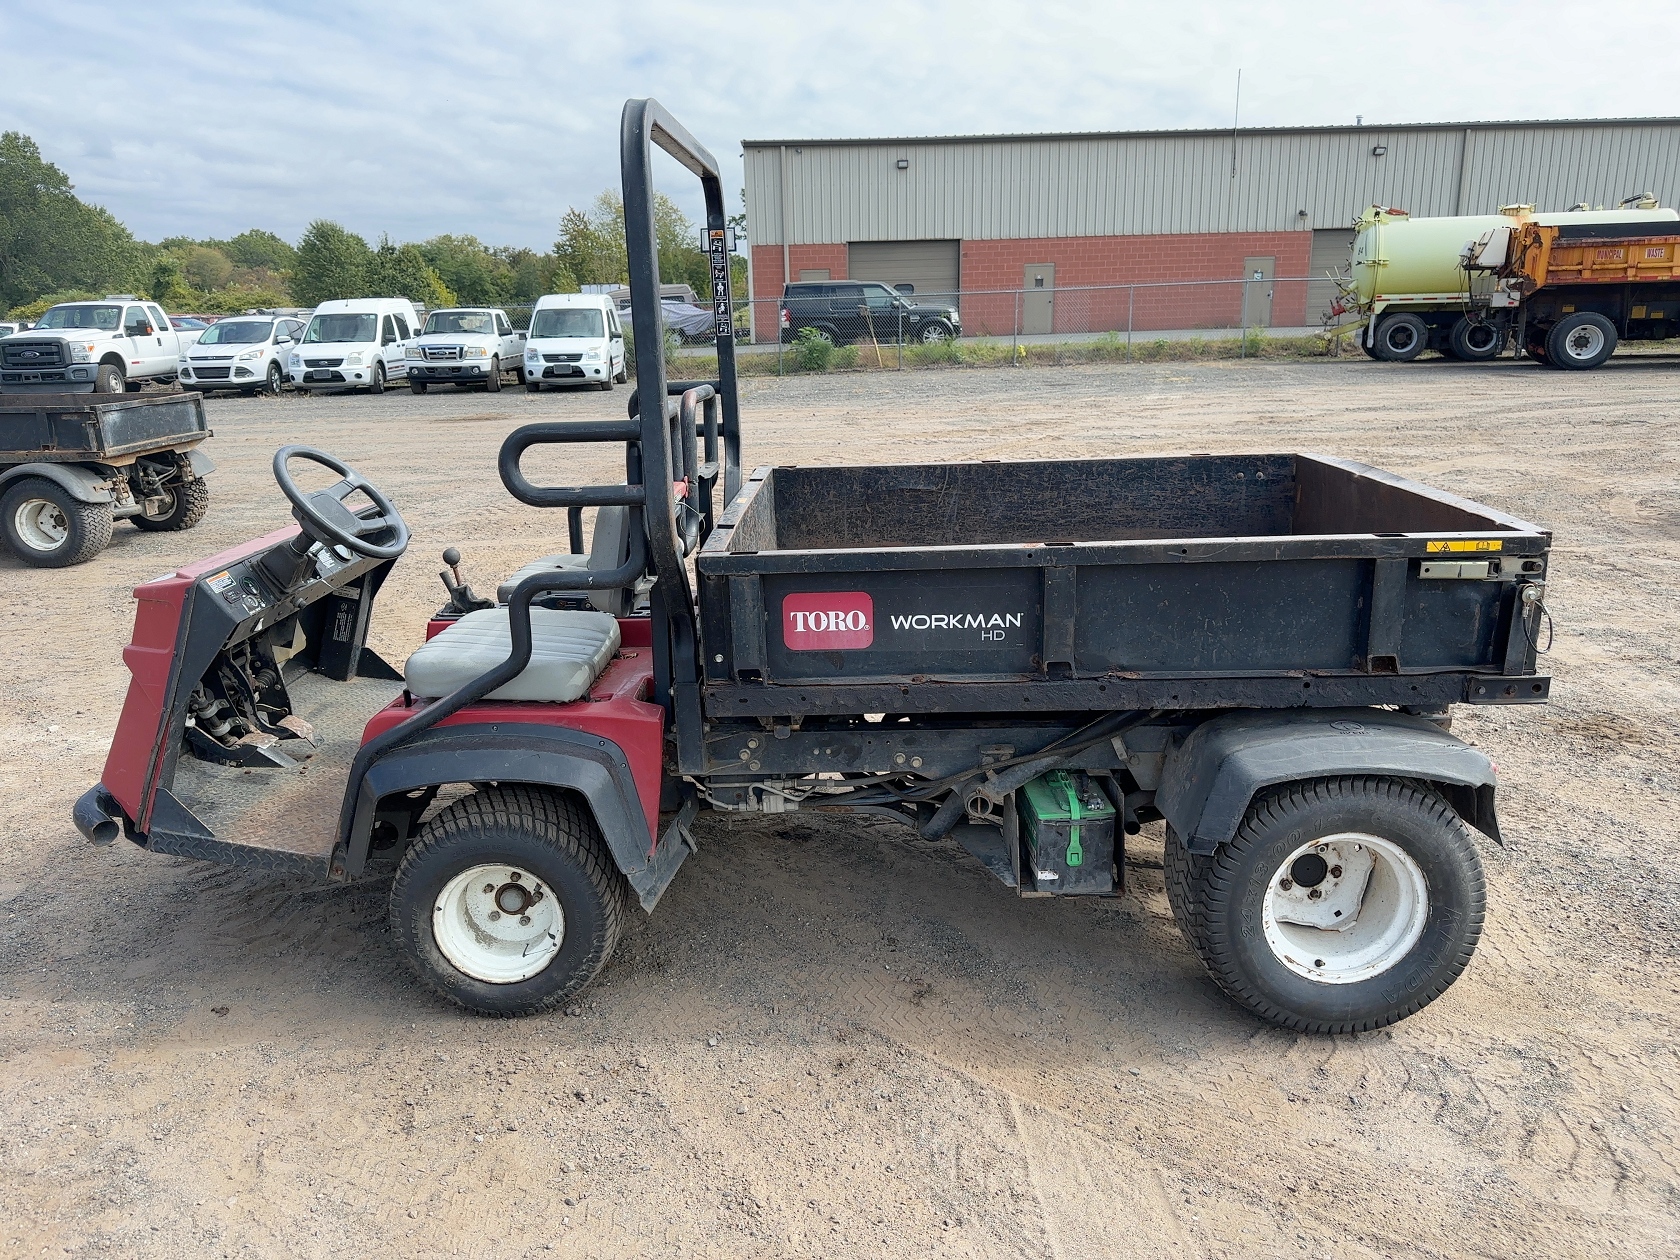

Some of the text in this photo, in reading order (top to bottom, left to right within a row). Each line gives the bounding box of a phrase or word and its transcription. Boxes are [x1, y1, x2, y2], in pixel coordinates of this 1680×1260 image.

[1646, 248, 1664, 258] WASTE
[891, 613, 1022, 630] WORKMAN
[981, 630, 1005, 641] HD
[1380, 906, 1462, 1004] KENDA
